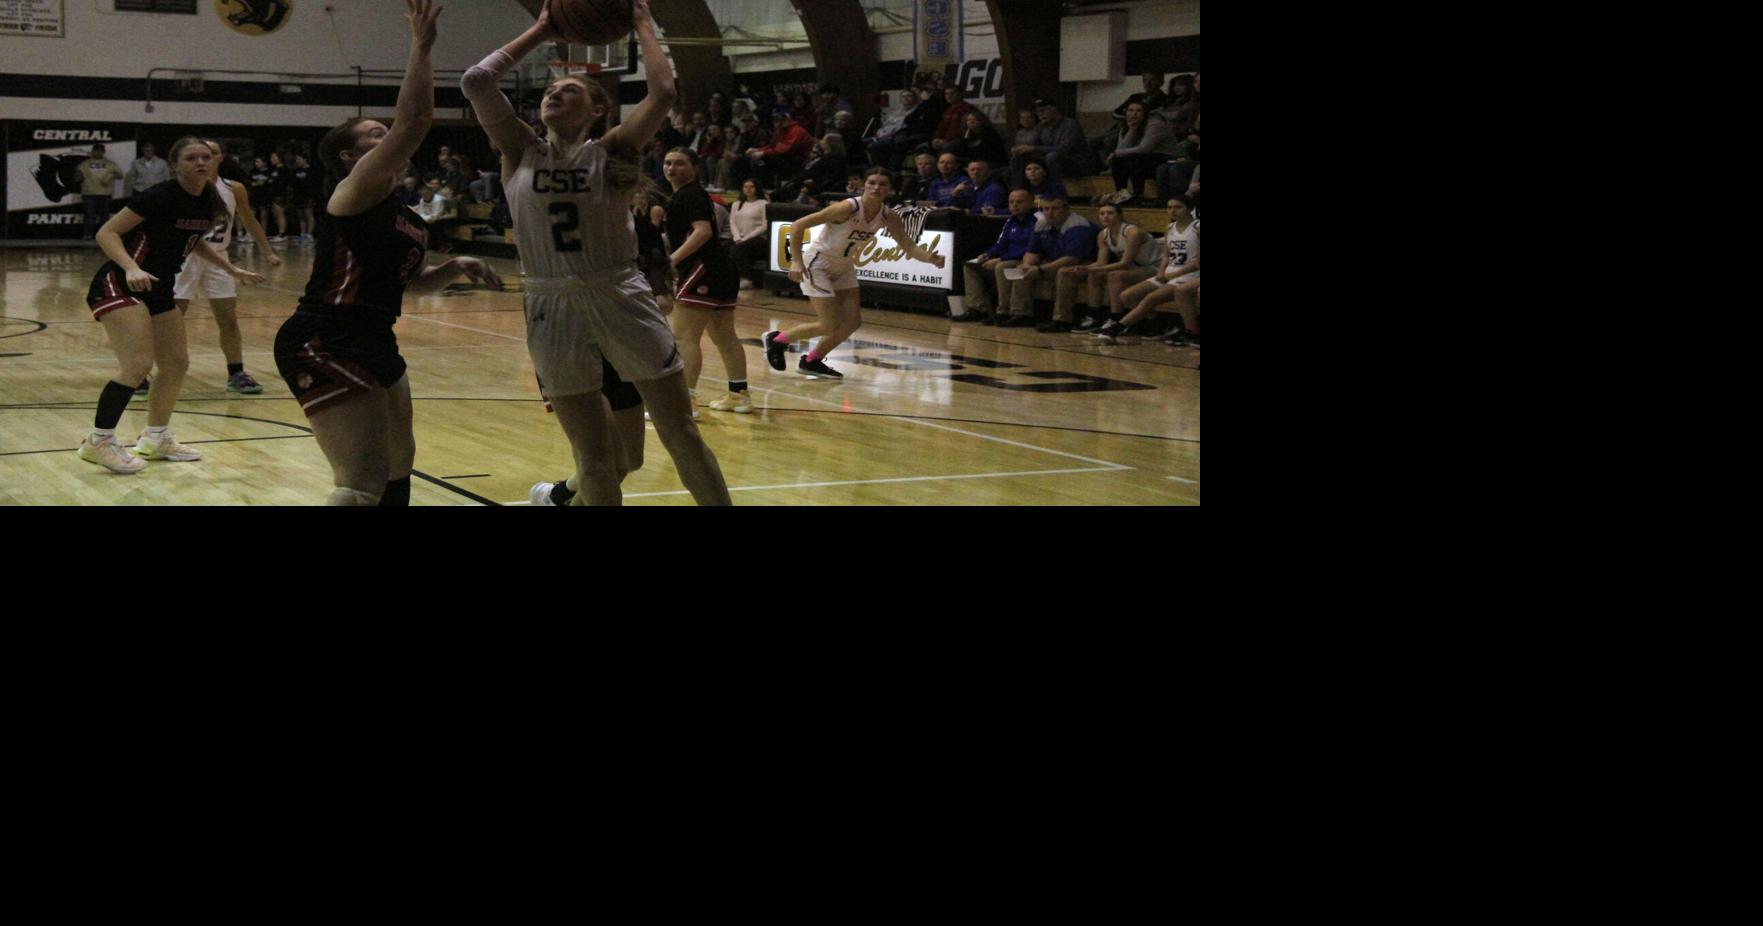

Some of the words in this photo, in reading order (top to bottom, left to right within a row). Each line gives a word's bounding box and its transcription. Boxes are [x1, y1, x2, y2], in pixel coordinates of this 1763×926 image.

[33, 129, 112, 142] CENTRAL
[533, 168, 592, 193] CSE
[26, 213, 100, 224] PANTH
[549, 202, 582, 252] 2
[1169, 240, 1188, 250] CSE
[855, 268, 899, 281] EXCELLENCE
[902, 273, 910, 282] IS
[912, 274, 918, 283] A
[920, 275, 943, 286] HABIT
